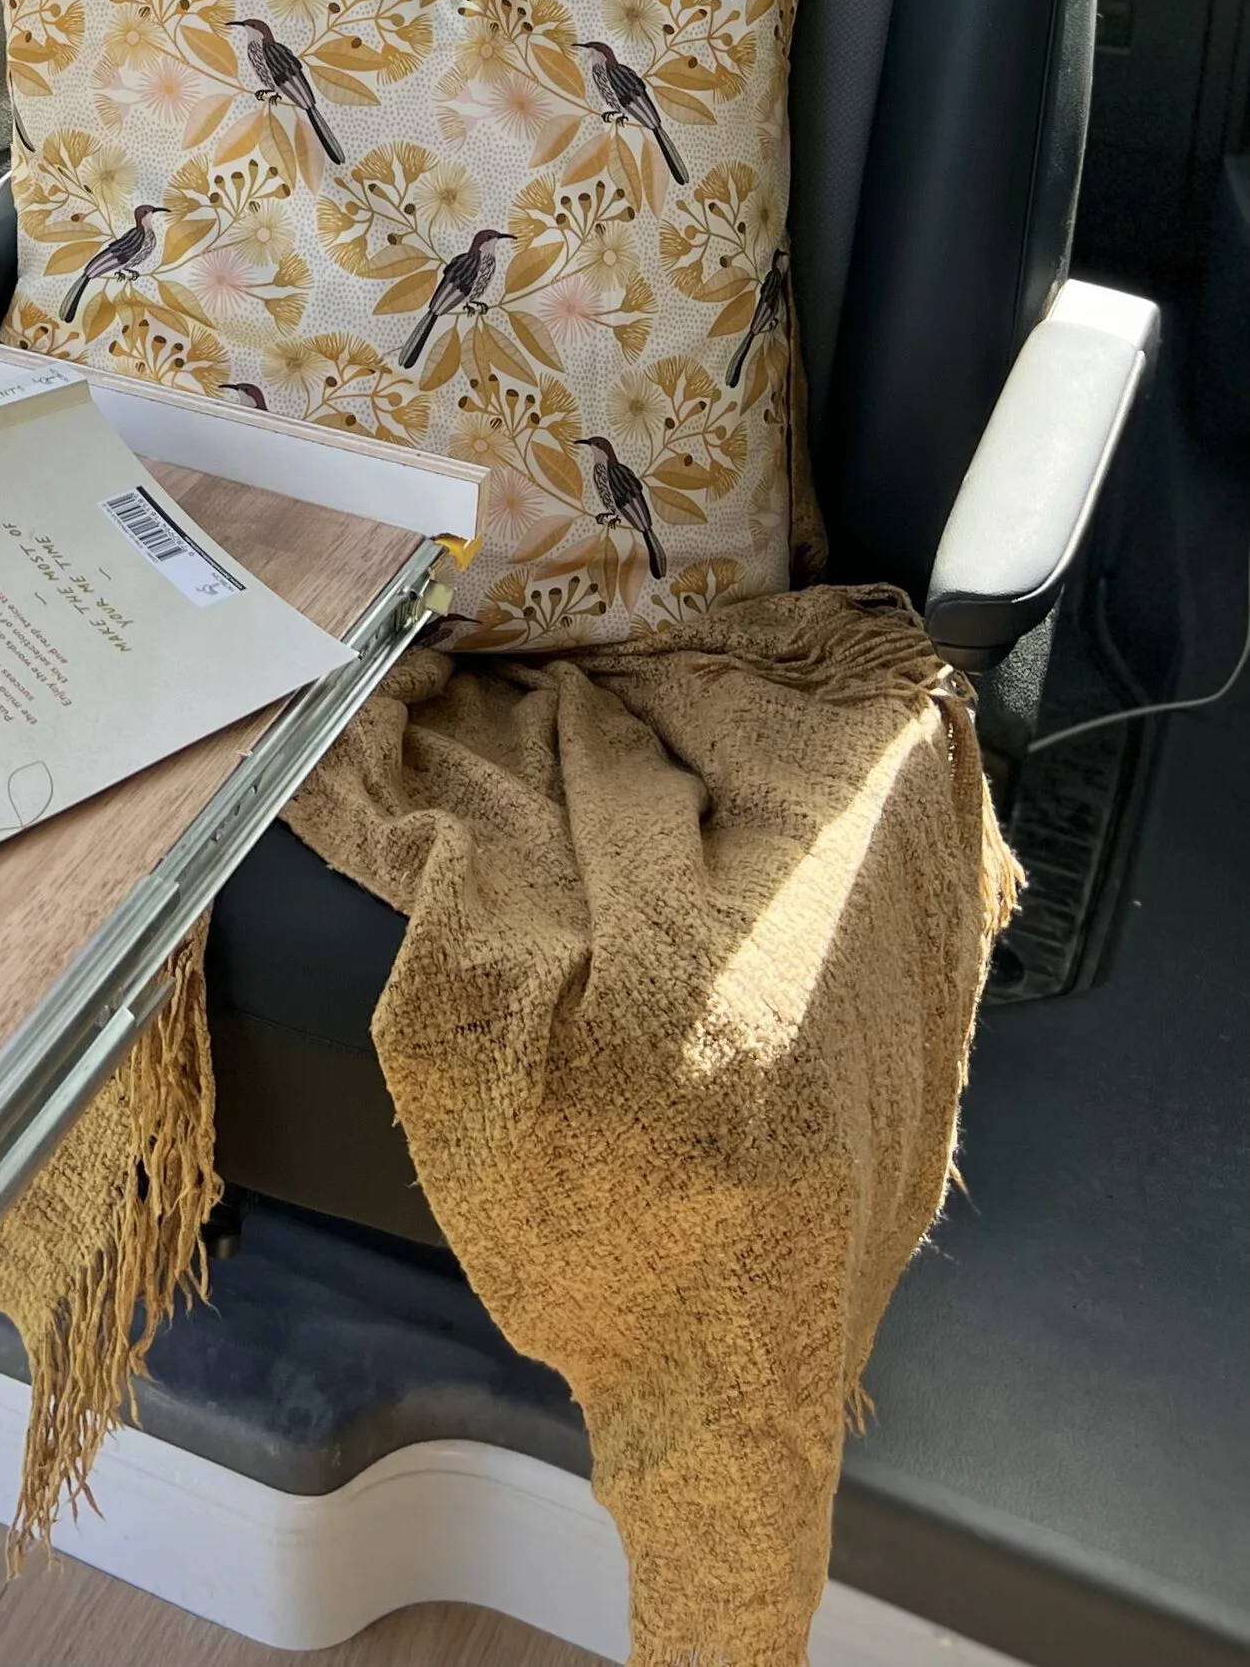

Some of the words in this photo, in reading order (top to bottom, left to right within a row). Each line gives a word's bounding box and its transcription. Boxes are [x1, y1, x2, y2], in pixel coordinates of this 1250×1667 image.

[2, 520, 22, 538] OF
[18, 541, 60, 583] MOST
[34, 533, 72, 571] TIME
[68, 573, 94, 595] ME
[56, 583, 90, 616] THE
[94, 593, 134, 631] YOUR
[6, 603, 32, 629] twice
[12, 627, 52, 668] selection
[30, 627, 52, 649] reap
[88, 615, 132, 655] MAKE
[4, 639, 32, 667] words
[48, 647, 68, 665] and
[0, 667, 34, 703] success
[30, 666, 48, 683] the
[49, 665, 68, 685] this
[45, 681, 72, 707] Enjoy
[20, 707, 38, 725] the
